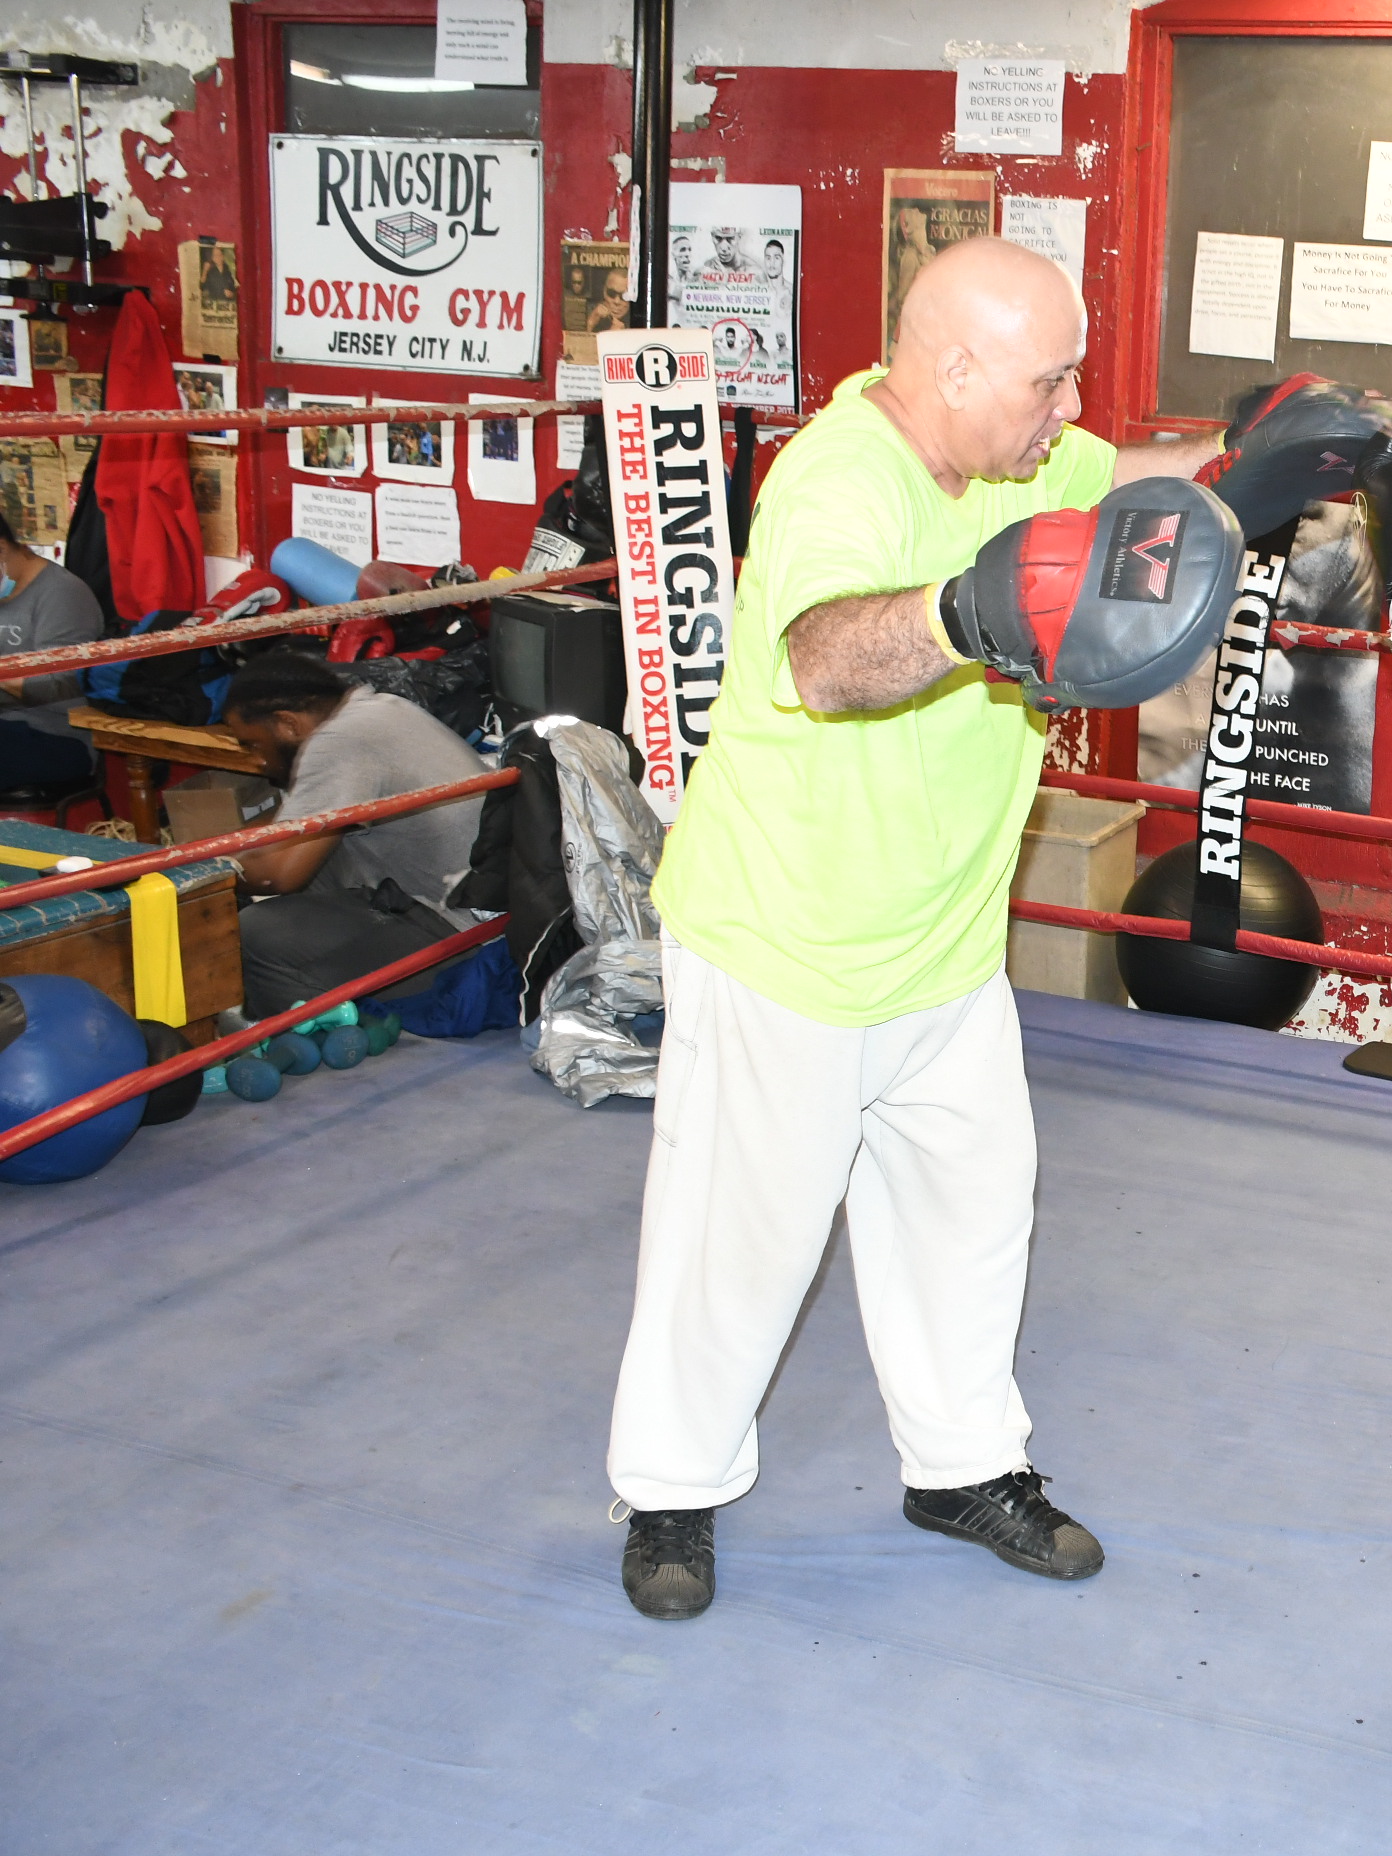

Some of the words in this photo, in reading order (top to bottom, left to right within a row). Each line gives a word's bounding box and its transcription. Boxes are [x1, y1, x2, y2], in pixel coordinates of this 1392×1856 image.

[983, 66, 998, 76] NO
[1001, 67, 1044, 77] YELLING
[968, 81, 1043, 92] INSTRUCTIONS
[1046, 83, 1058, 92] AT
[970, 96, 1012, 106] BOXERS
[1014, 97, 1029, 107] OR
[1032, 98, 1054, 108] YOU
[966, 111, 988, 121] WILL
[991, 112, 1004, 122] BE
[1007, 112, 1041, 122] ASKED
[1044, 114, 1058, 123] TO
[991, 127, 1031, 138] LEAVE!!!
[316, 147, 500, 277] RINGSIDE
[1010, 200, 1042, 210] BOXING
[1048, 202, 1058, 210] IS
[1010, 213, 1025, 222] NOT
[1008, 225, 1036, 234] GOING
[1042, 227, 1052, 236] TO
[571, 252, 578, 265] A
[1302, 249, 1332, 260] Money
[1344, 252, 1360, 260] Not
[1362, 253, 1388, 264] Going
[1313, 265, 1352, 276] Sacrafice
[1354, 268, 1368, 277] For
[1370, 269, 1387, 278] You
[1302, 282, 1318, 291] You
[1320, 283, 1342, 293] Have
[1345, 284, 1356, 294] To
[285, 277, 420, 324] BOXING
[448, 288, 526, 331] GYM
[725, 294, 742, 304] NEW
[744, 295, 772, 306] JERSEY
[1324, 299, 1338, 308] For
[1341, 300, 1371, 312] Money
[328, 331, 397, 357] JERSEY
[409, 336, 450, 361] CITY
[461, 339, 490, 364] N.J.
[606, 357, 634, 382] RING
[642, 351, 670, 386] R
[678, 355, 706, 379] SIDE
[758, 373, 791, 386] NIGHT
[616, 404, 650, 481] THE
[312, 492, 324, 502] NO
[326, 494, 357, 506] YELLING
[302, 504, 356, 518] INSTRUCTIONS
[303, 517, 334, 528] BOXERS
[335, 520, 347, 530] OR
[350, 522, 366, 532] YOU
[1118, 512, 1138, 544] Victory
[300, 529, 318, 539] WILL
[319, 531, 330, 540] BE
[332, 532, 357, 543] ASKED
[358, 536, 368, 546] TO
[624, 492, 658, 587] BEST
[1112, 546, 1128, 592] Athletics
[650, 404, 724, 794] RINGSID
[632, 596, 662, 637] IN
[638, 648, 675, 792] BOXING
[1200, 550, 1286, 881] RINGSIDE
[1256, 718, 1300, 736] UNTIL
[1255, 744, 1329, 767] PUNCHED
[1274, 774, 1312, 792] FACE
